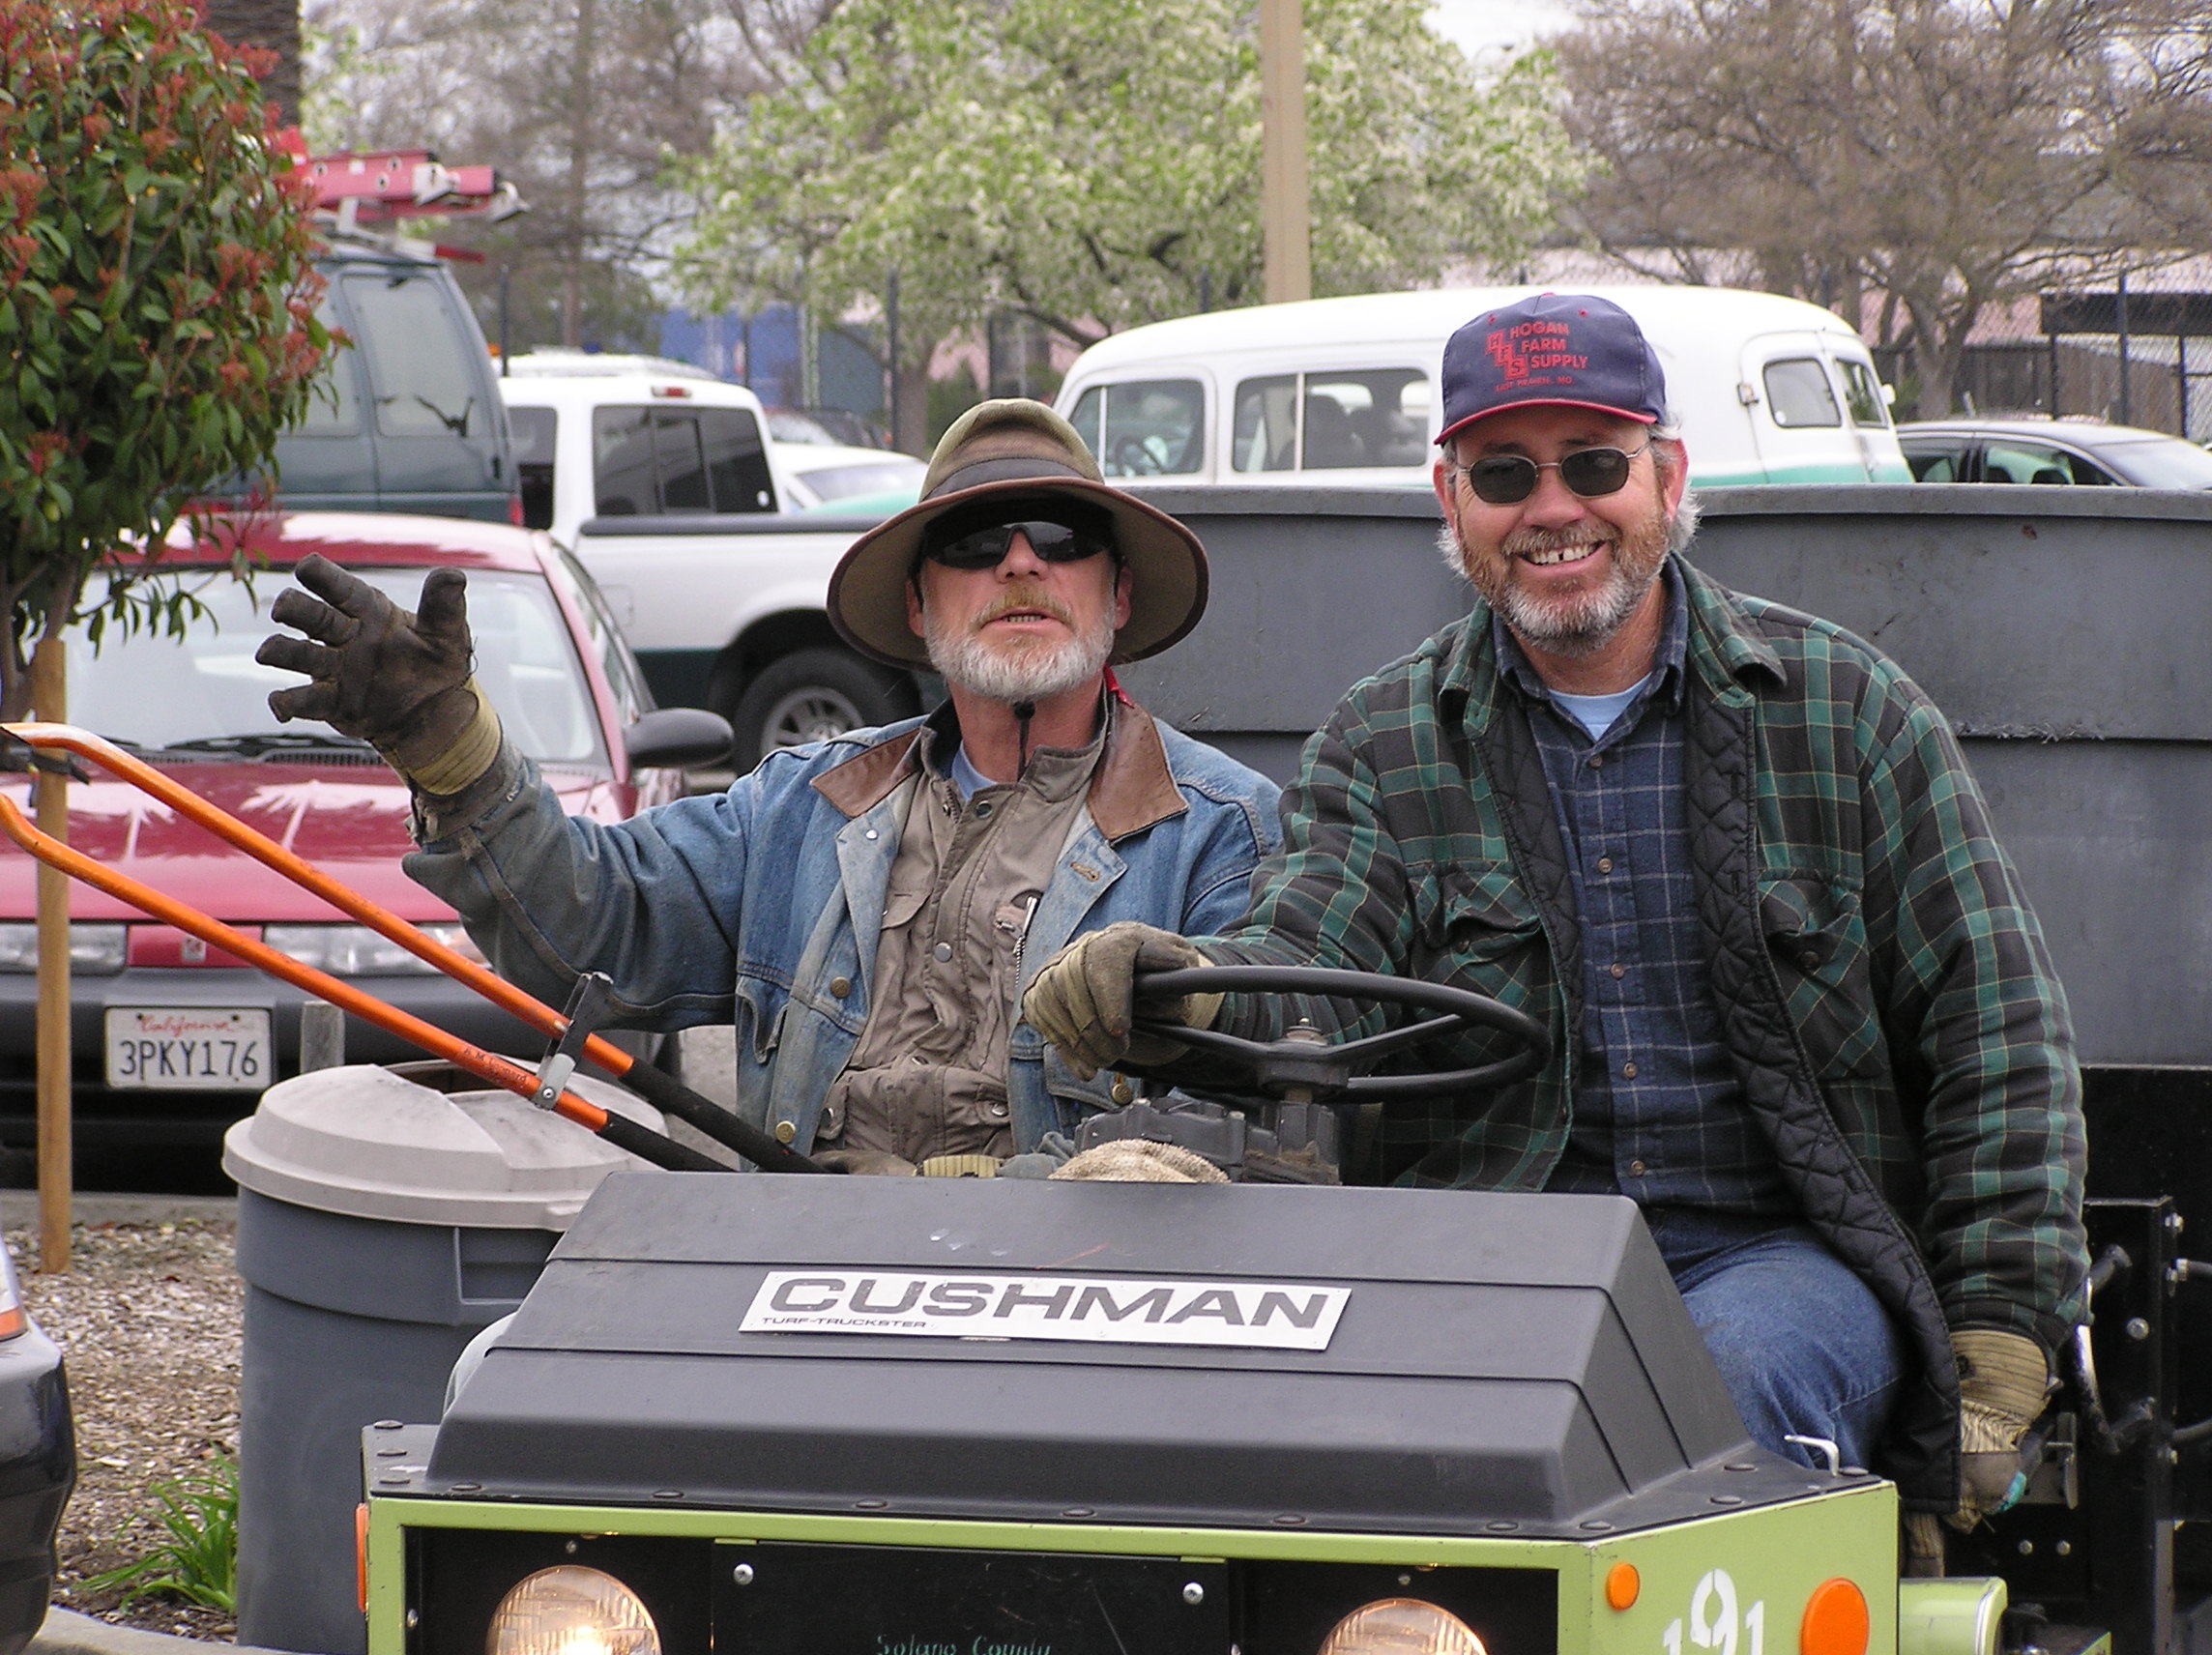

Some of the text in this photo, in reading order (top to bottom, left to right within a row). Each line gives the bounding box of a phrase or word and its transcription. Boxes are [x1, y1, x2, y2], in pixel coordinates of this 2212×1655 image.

[1510, 321, 1569, 338] HOGAN
[1521, 338, 1566, 354] FARM
[1530, 354, 1587, 369] SUPPLY
[141, 1015, 234, 1038] California
[120, 1040, 257, 1080] 3PKY176
[770, 1278, 1329, 1328] CUSHMAN
[762, 1317, 927, 1328] TURF-TRUCKSTER
[1663, 1568, 1764, 1655] 191
